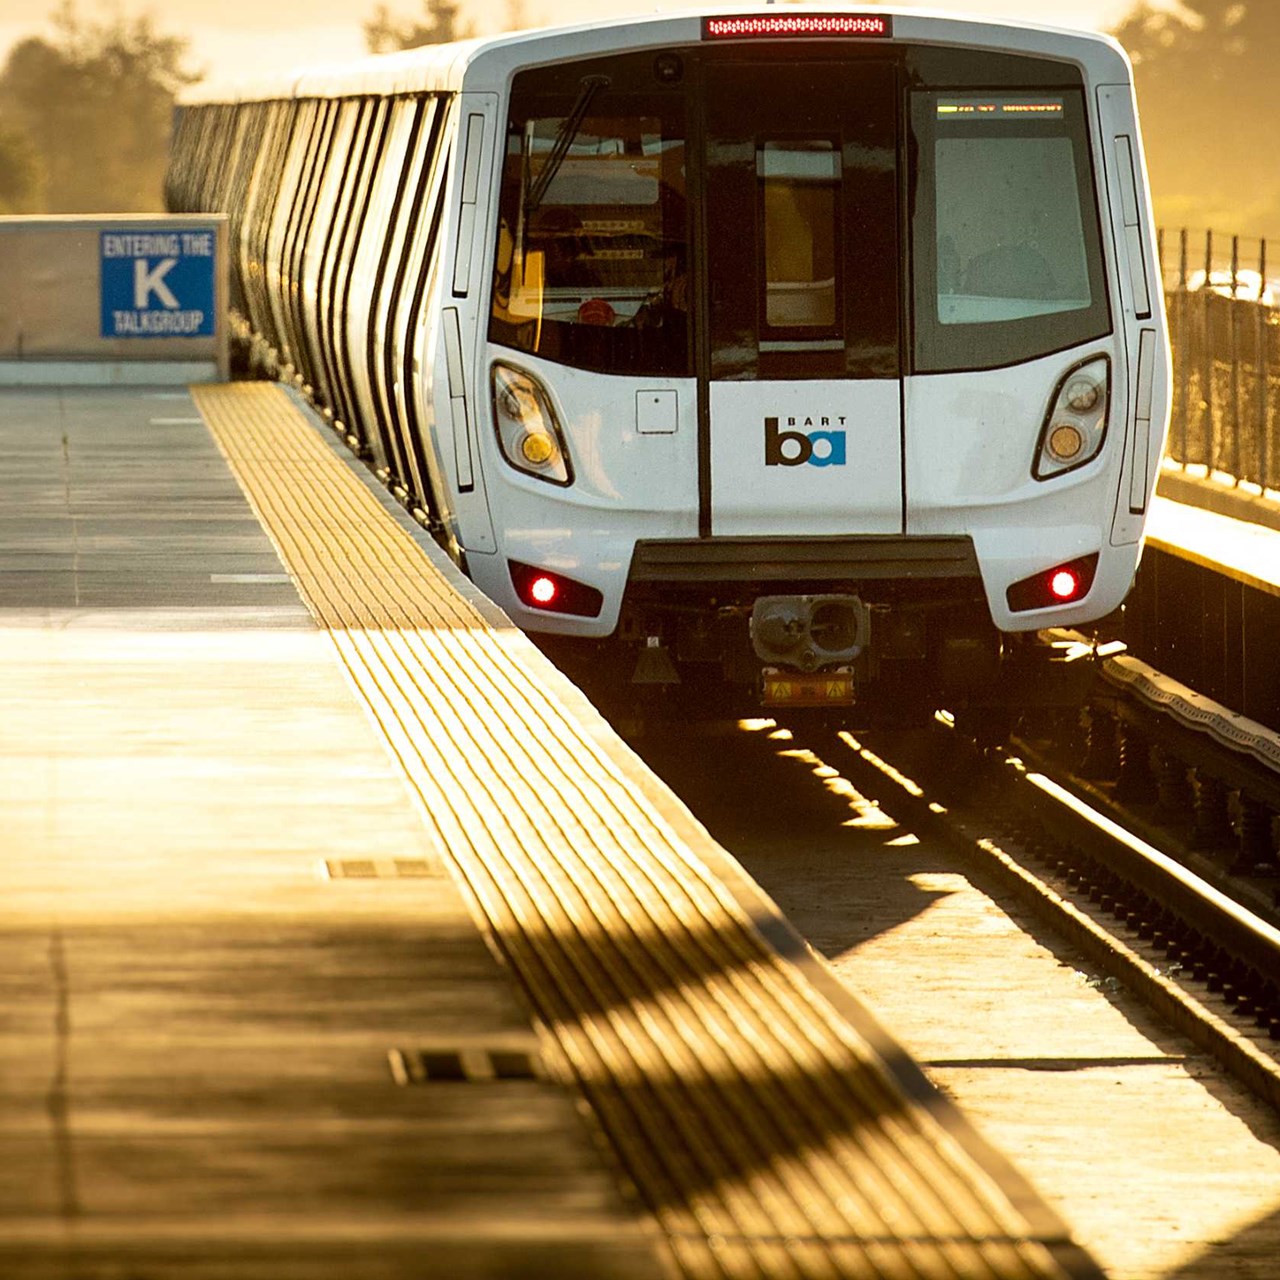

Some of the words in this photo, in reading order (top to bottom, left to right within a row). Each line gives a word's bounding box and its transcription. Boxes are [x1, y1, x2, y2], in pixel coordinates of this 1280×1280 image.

[103, 234, 180, 258] ENTERING
[181, 233, 211, 256] THE
[135, 259, 180, 308] K
[114, 310, 204, 333] TALKGROUP
[787, 417, 847, 426] BART
[764, 417, 847, 467] ba
